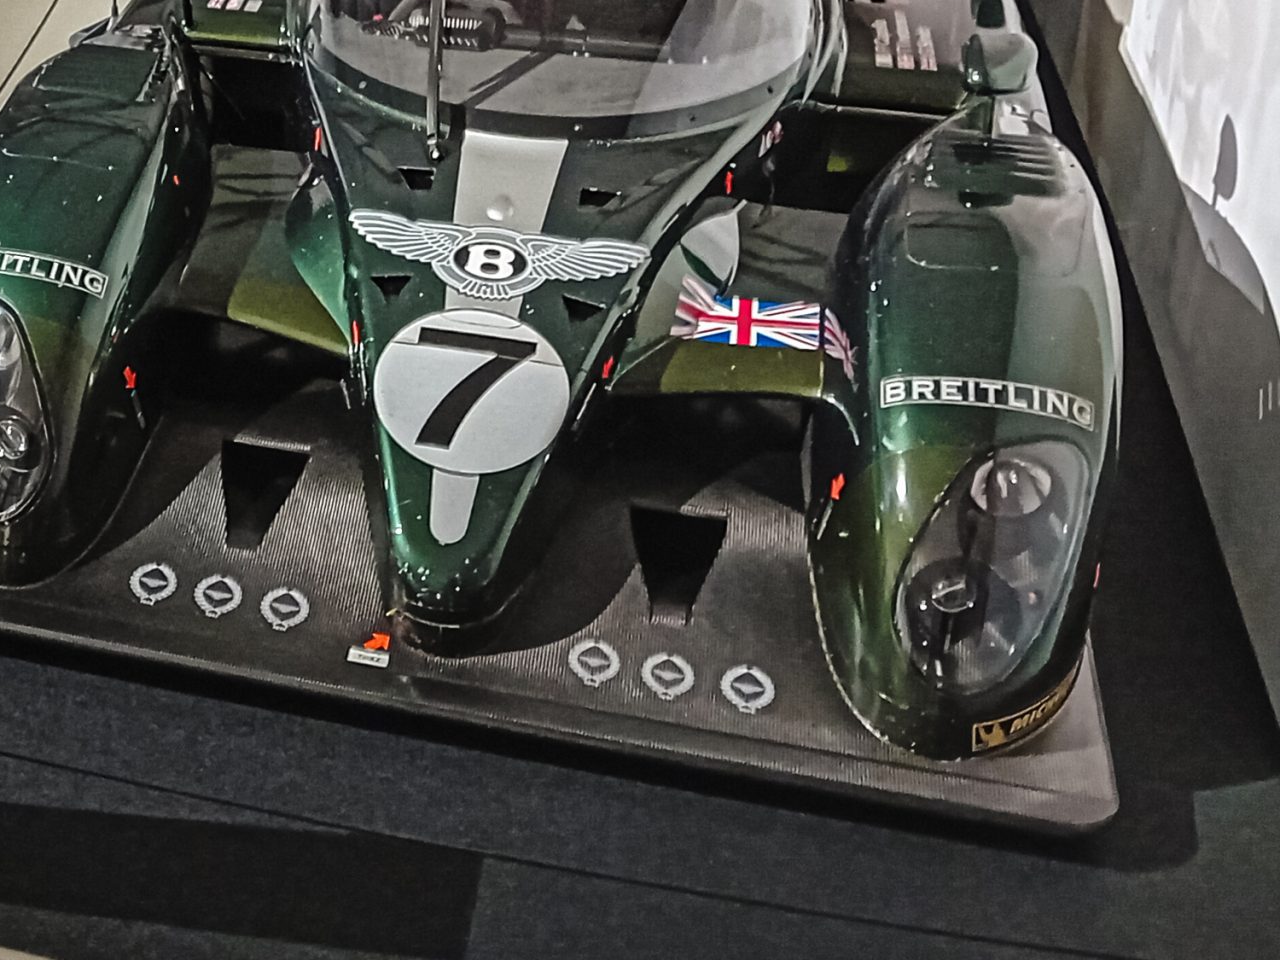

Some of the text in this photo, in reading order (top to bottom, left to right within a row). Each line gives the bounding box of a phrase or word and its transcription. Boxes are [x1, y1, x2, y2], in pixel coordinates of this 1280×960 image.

[464, 244, 516, 280] B
[415, 326, 538, 450] 7
[885, 380, 1092, 426] BREITLING
